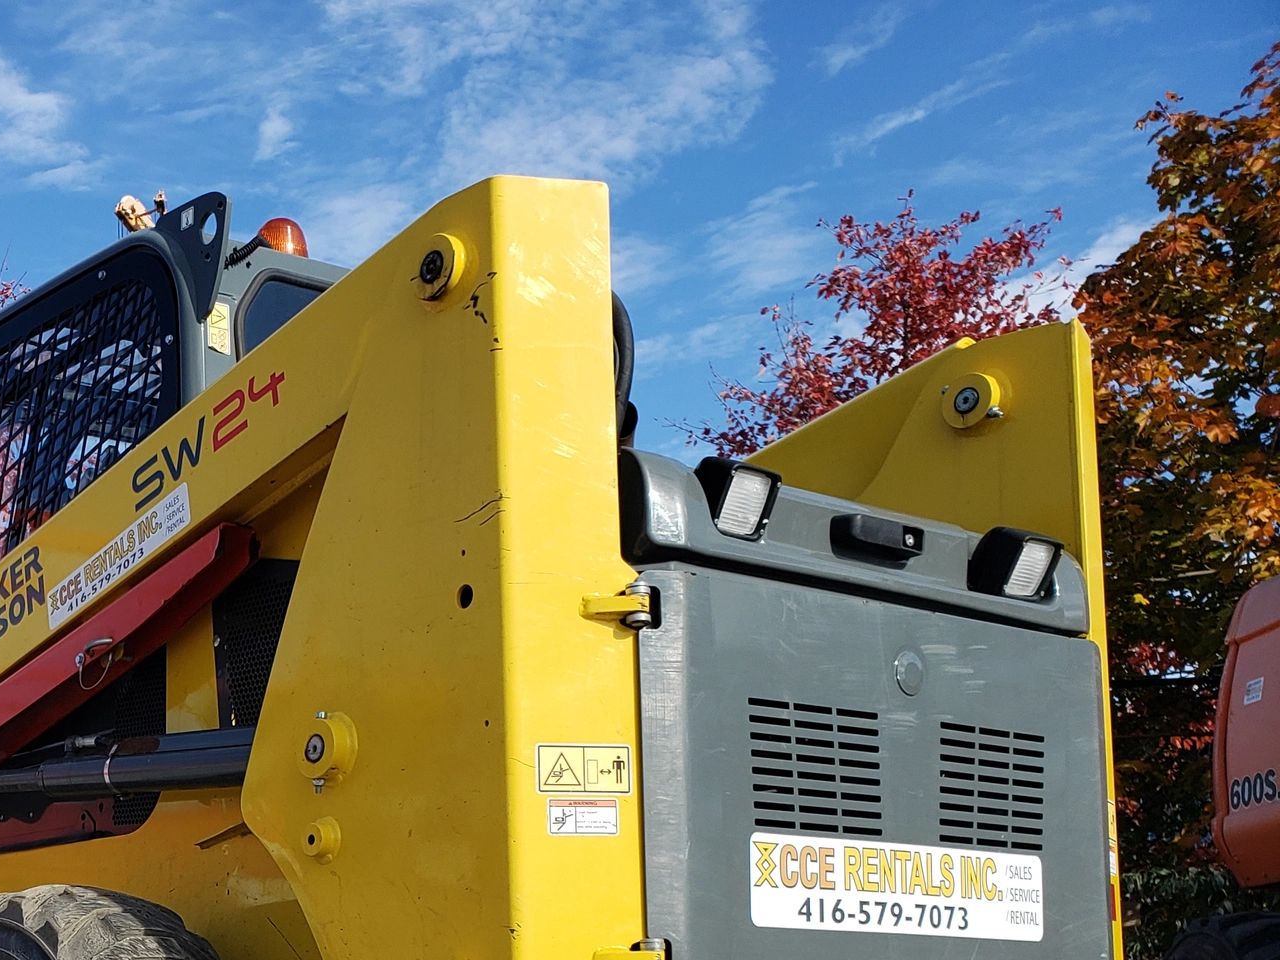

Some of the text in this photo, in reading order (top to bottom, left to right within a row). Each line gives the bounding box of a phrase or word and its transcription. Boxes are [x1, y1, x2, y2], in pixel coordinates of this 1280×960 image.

[58, 510, 163, 606] CCE RENTALS INC.
[67, 548, 144, 612] 416-579-7073
[1230, 769, 1280, 810] 600S
[779, 844, 1004, 902] CCE RENTALS INC.
[798, 897, 969, 930] 416-579-7073
